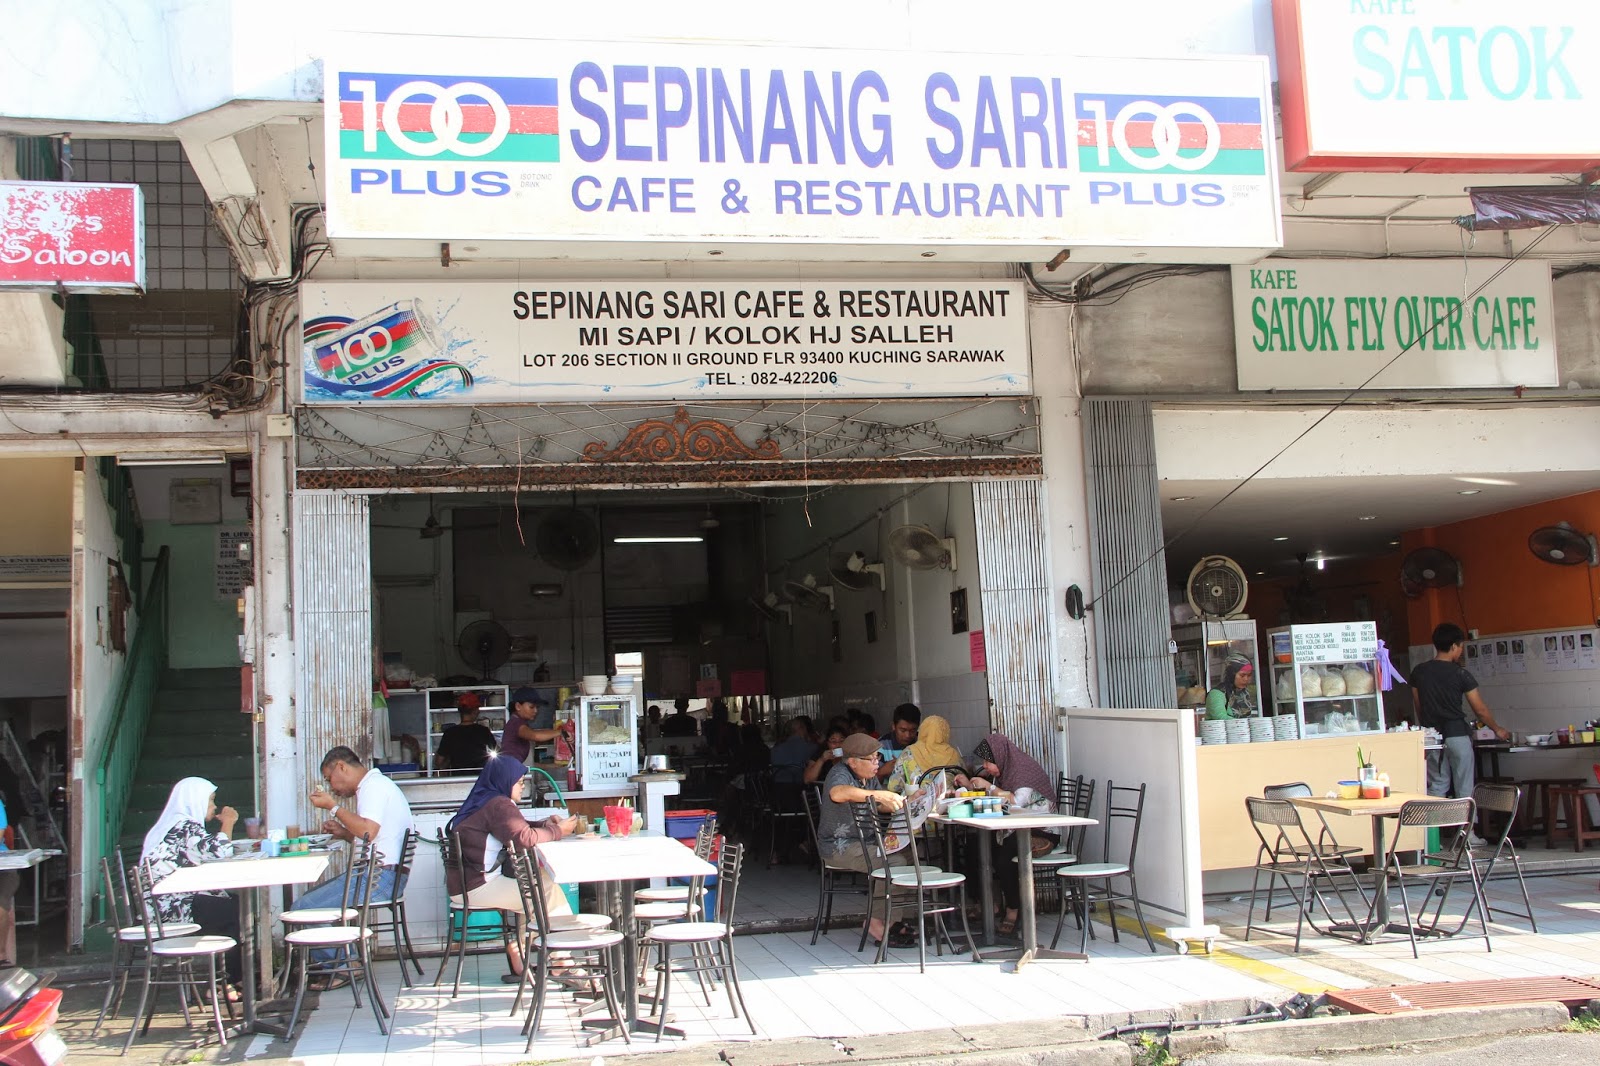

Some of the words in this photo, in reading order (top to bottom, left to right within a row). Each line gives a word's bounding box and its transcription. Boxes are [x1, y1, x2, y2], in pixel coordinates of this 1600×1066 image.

[1352, 25, 1583, 101] SATOK
[349, 79, 511, 157] 100
[569, 62, 894, 168] SEPINANG
[925, 71, 1068, 170] SARI
[1083, 99, 1221, 171] 100
[351, 168, 511, 197] PLUS
[520, 173, 553, 181] ISOTONIC
[571, 175, 696, 213] CAFE
[721, 178, 750, 215] &
[775, 180, 1070, 218] RESTAURANT
[1089, 181, 1225, 207] PLUS
[0, 236, 131, 267] Saloon
[1250, 269, 1298, 290] KAFE
[513, 291, 654, 320] SEPINANG
[663, 290, 726, 319] SARI
[734, 290, 805, 318] CAFE
[813, 290, 831, 318] &
[839, 290, 1010, 318] RESTAURANT
[579, 327, 608, 346] MI
[615, 327, 680, 346] SAPI
[689, 326, 696, 345] /
[705, 325, 801, 345] KOLOK
[810, 325, 842, 344] HJ
[851, 325, 954, 344] SALLEH
[1251, 296, 1339, 352] SATOK
[1346, 296, 1389, 351] FLY
[1394, 295, 1466, 351] OVER
[1472, 296, 1539, 351] CAFE
[330, 326, 393, 373] 100
[523, 354, 556, 368] LOT
[561, 354, 589, 367] 206
[594, 353, 666, 367] SECTION
[672, 353, 682, 365] II
[686, 352, 758, 365] GROUND
[763, 352, 796, 365] FLR
[799, 351, 844, 364] 93400
[849, 350, 922, 364] KUCHING
[926, 350, 1005, 363] SARAWAK
[347, 355, 405, 385] PLUS
[705, 373, 736, 385] TEL
[751, 371, 837, 385] 082-422206
[587, 750, 608, 760] MEE
[609, 748, 632, 759] SAPI
[599, 760, 620, 770] HAJI
[591, 771, 628, 780] SALLEH
